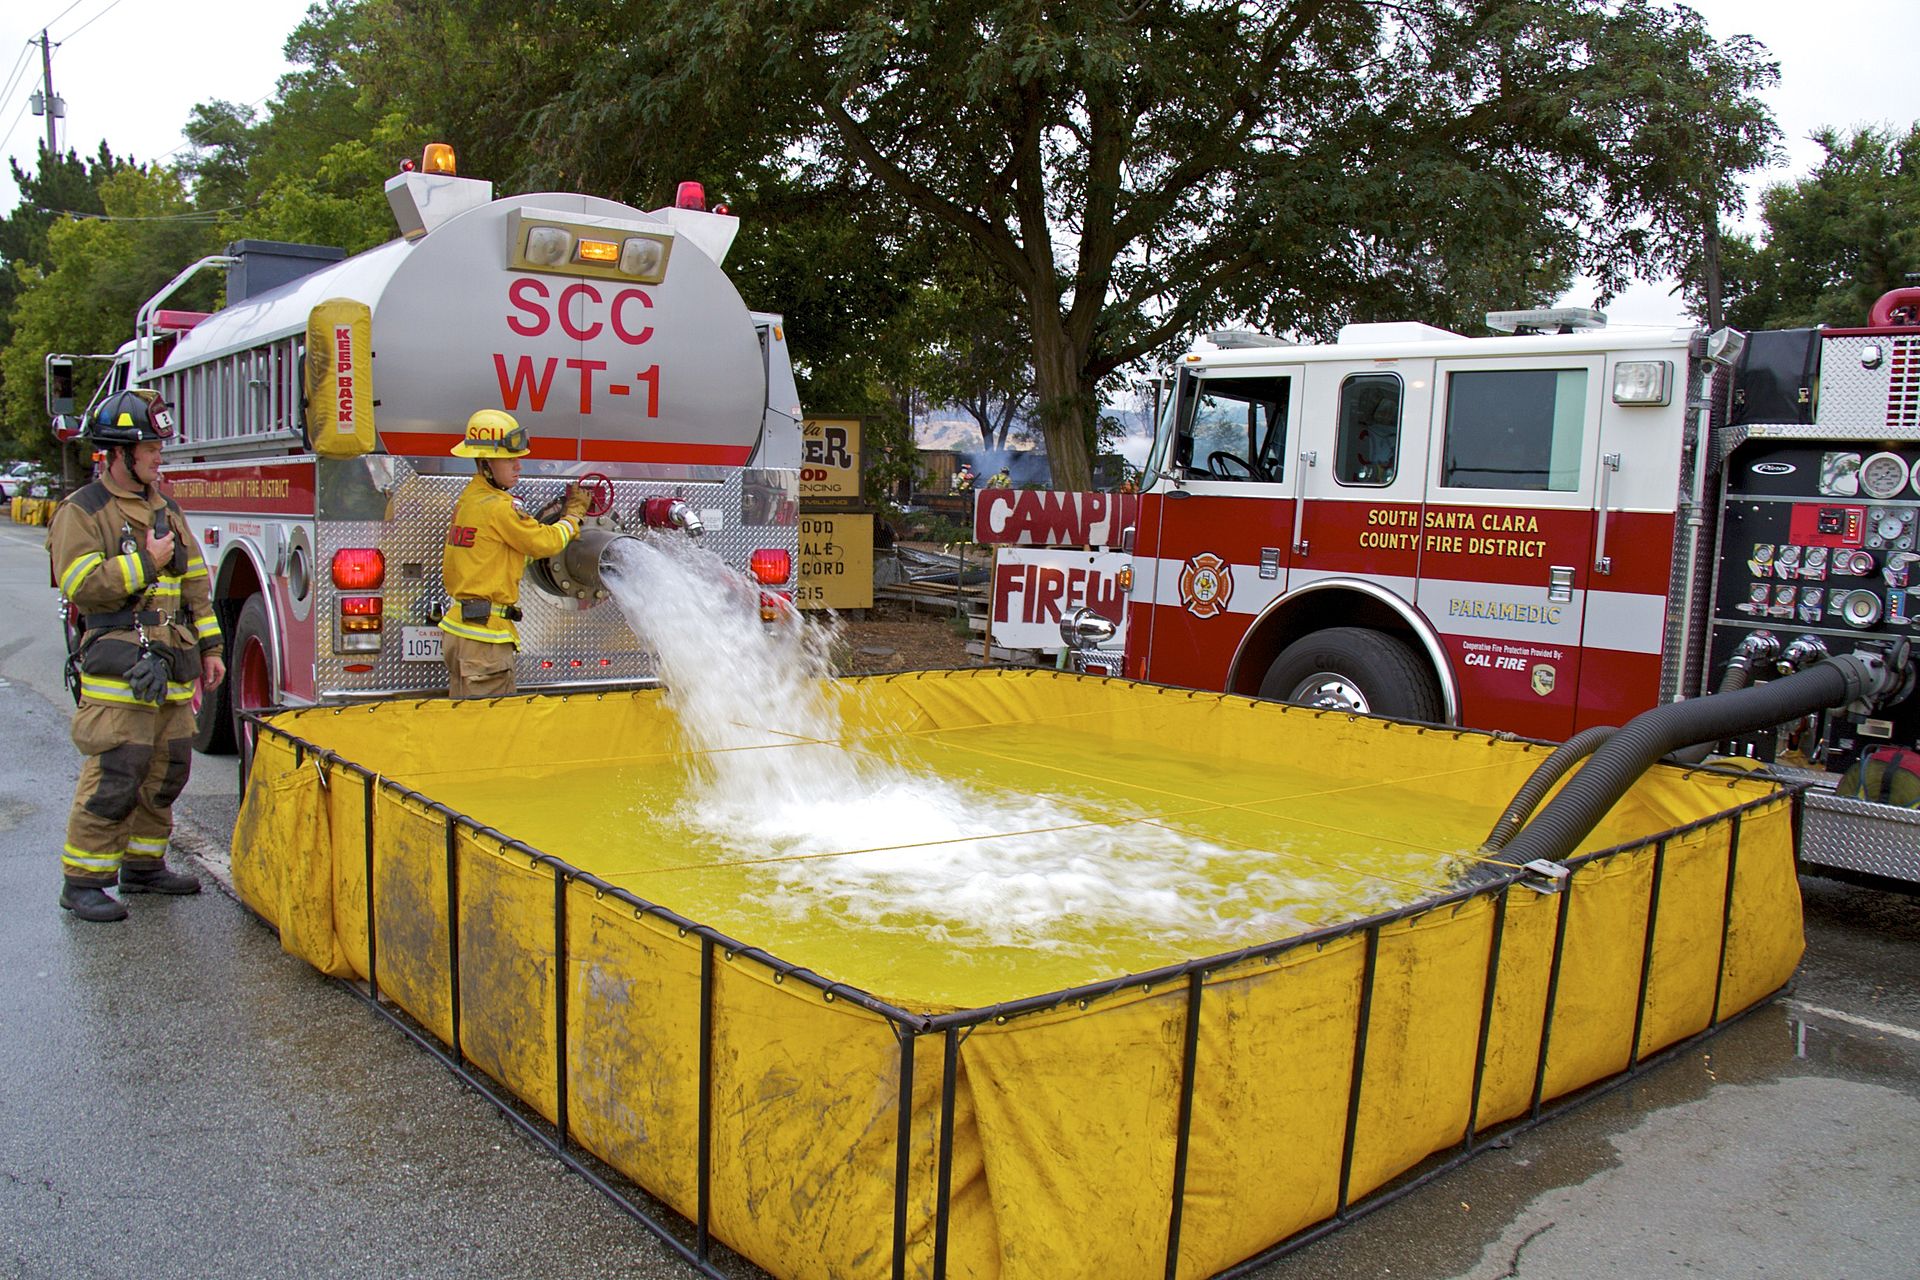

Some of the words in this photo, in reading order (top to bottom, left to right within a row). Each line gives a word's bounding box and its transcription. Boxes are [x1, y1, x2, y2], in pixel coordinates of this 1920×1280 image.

[507, 278, 654, 345] SCC
[336, 329, 352, 373] KEEP
[493, 354, 660, 418] WT-1
[338, 377, 353, 422] BACK
[162, 413, 169, 425] 2
[801, 427, 852, 469] ER
[173, 481, 188, 498] SOUTH
[189, 481, 205, 498] SANTA
[206, 481, 221, 498] CLARA
[223, 480, 244, 498] COUNTY
[246, 480, 259, 498] FIRE
[261, 479, 289, 498] DISTRICT
[1368, 509, 1418, 527] SOUTH
[1424, 511, 1476, 530] SANTA
[1481, 514, 1539, 533] CLARA
[798, 542, 833, 556] ALE
[1359, 532, 1420, 551] COUNTY
[1425, 535, 1463, 554] FIRE
[1468, 538, 1547, 558] DISTRICT
[802, 562, 844, 575] CORD
[1449, 598, 1562, 625] PARAMEDIC
[1462, 641, 1491, 652] Cooperative
[1492, 643, 1502, 652] Fire
[1503, 645, 1530, 656] Protection
[1530, 648, 1553, 658] Provided
[1464, 653, 1492, 667] CAL
[1494, 656, 1528, 671] FIRE
